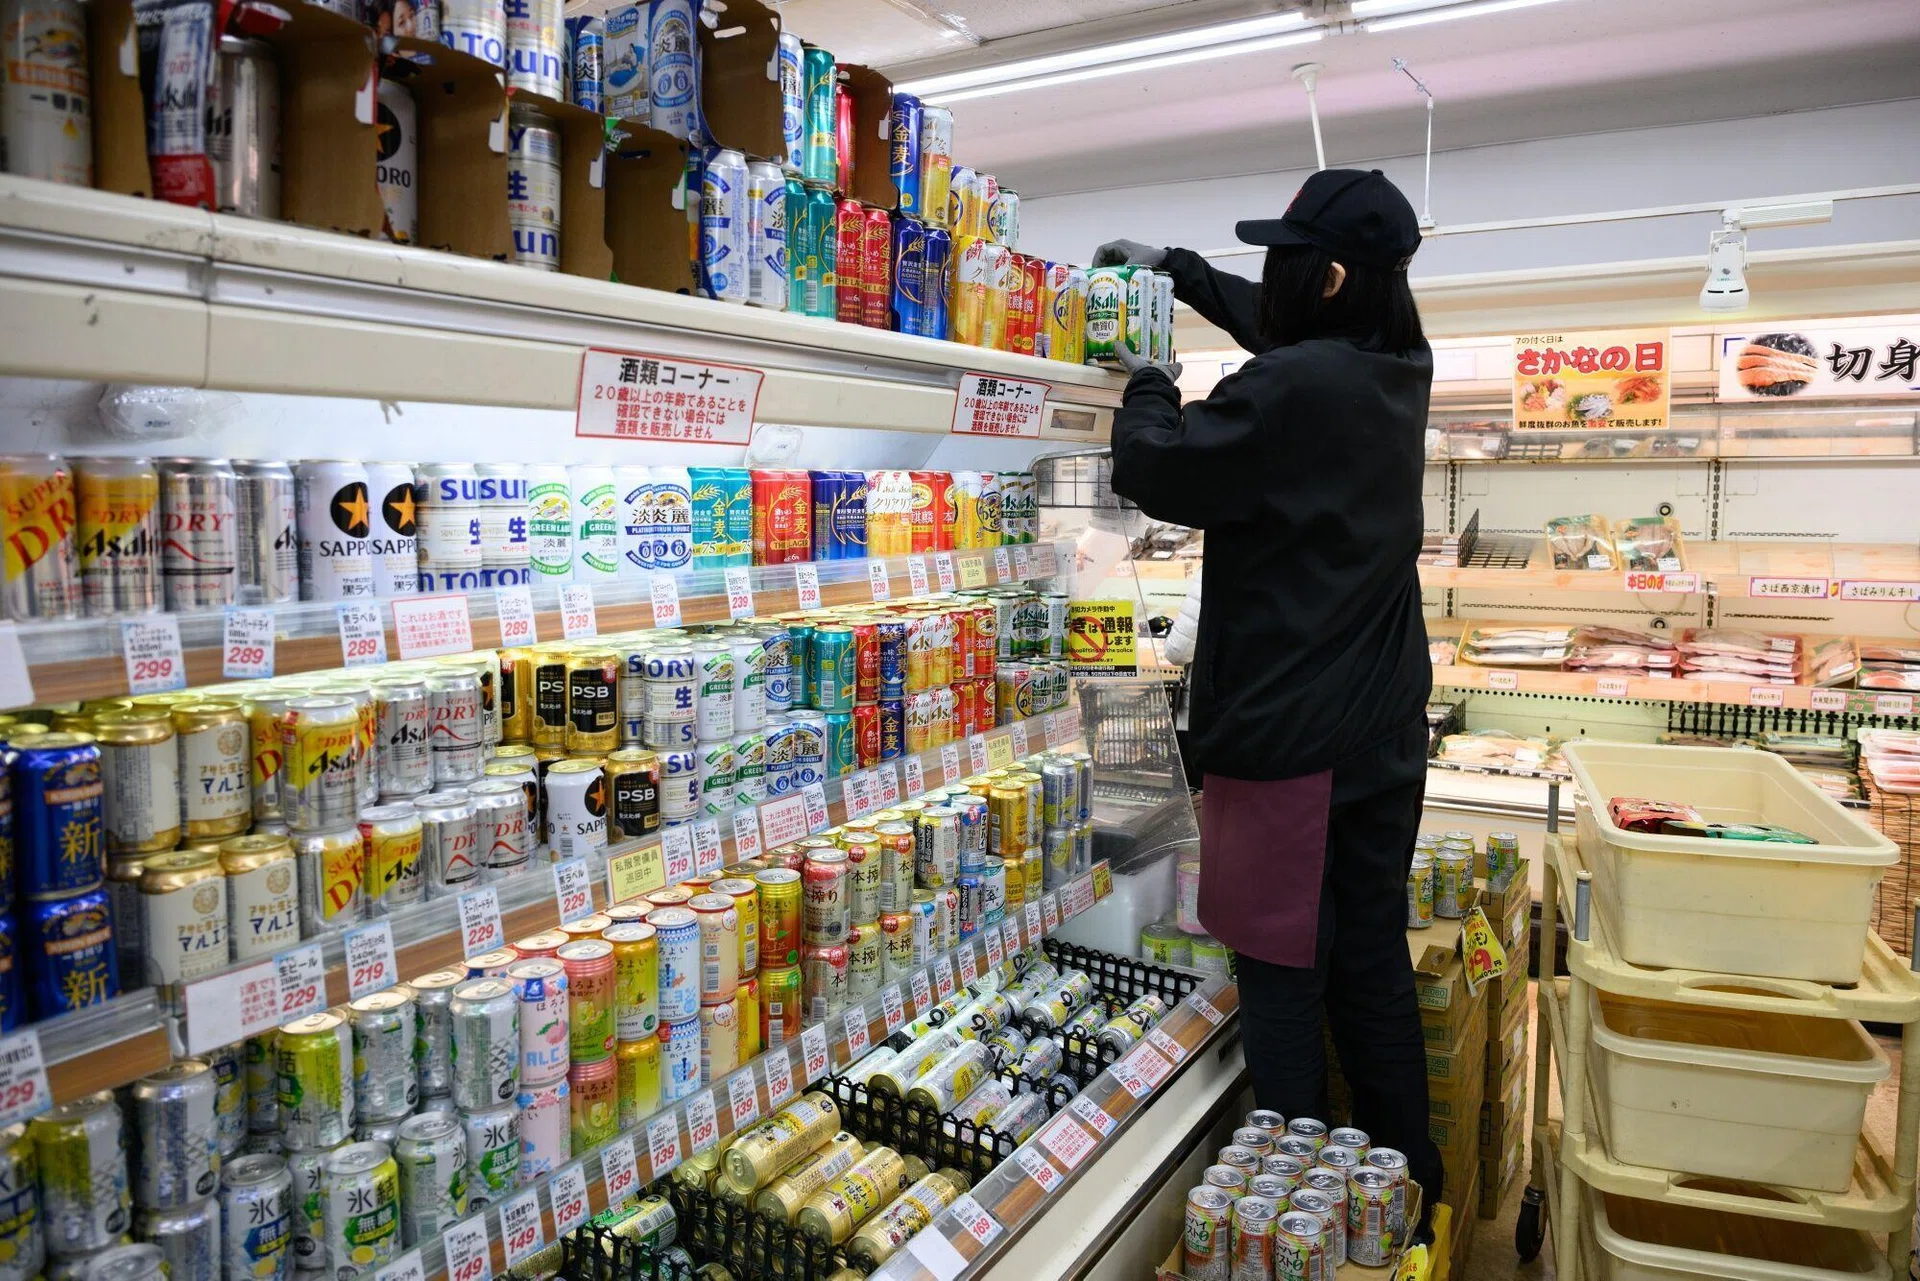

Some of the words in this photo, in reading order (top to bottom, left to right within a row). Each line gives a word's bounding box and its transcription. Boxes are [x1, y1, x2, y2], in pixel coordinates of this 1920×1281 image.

[892, 125, 911, 166] 金麦
[1515, 335, 1564, 345] 7の付く日は
[1516, 341, 1664, 376] さかなの日
[1825, 336, 1920, 384] 切身
[618, 357, 731, 389] 酒類コーナー
[976, 378, 1032, 399] 酒類コーナー
[594, 384, 747, 413] 20歳以上の年齢であることを
[964, 397, 1040, 415] 20歳以上の年齢であることを
[616, 403, 726, 426] 確認できない場合には
[972, 409, 1028, 425] 確認できない場合には
[615, 419, 714, 439] 酒類を販売しません
[971, 420, 1021, 435] 酒類を販売しません
[711, 498, 726, 538] 金麦
[792, 497, 809, 535] 金麦
[508, 516, 527, 543] 生
[873, 582, 886, 594] 239
[913, 578, 926, 590] 239
[941, 575, 952, 585] 239
[801, 589, 816, 602] 239
[1760, 583, 1821, 596] さば西京漬け
[1850, 586, 1915, 598] さばみりん干し
[732, 594, 749, 609] 239
[342, 612, 377, 625] 黒ラベル
[656, 603, 675, 619] 239
[504, 621, 528, 637] 289
[567, 614, 589, 630] 239
[347, 638, 377, 657] 289
[1106, 636, 1133, 646] します
[227, 646, 265, 665] 289
[133, 659, 173, 681] 299
[572, 685, 609, 698] PSB
[674, 685, 693, 710] 生
[883, 716, 899, 751] 金麦
[973, 756, 984, 769] 189
[945, 766, 957, 780] 189
[882, 788, 897, 801] 189
[908, 778, 921, 793] 189
[618, 788, 656, 802] PSB
[855, 797, 869, 811] 189
[808, 810, 825, 825] 189
[60, 816, 101, 865] 新
[738, 836, 757, 852] 189
[615, 852, 659, 872] 私服警備員
[699, 848, 717, 865] 219
[625, 867, 652, 885] 巡回中
[669, 858, 688, 876] 219
[563, 892, 585, 913] 229
[468, 924, 494, 946] 229
[1029, 924, 1039, 936] 199
[1006, 938, 1018, 952] 199
[990, 948, 1000, 963] 119
[278, 956, 319, 977] 生ビール
[353, 961, 385, 987] 219
[962, 966, 974, 981] 139
[63, 964, 108, 1010] 新
[939, 979, 951, 995] 149
[282, 984, 317, 1012] 229
[915, 992, 928, 1009] 149
[887, 1009, 901, 1026] 149
[850, 1031, 865, 1048] 149
[808, 1055, 824, 1074] 139
[771, 1077, 788, 1097] 139
[1127, 1078, 1141, 1092] 179
[735, 1098, 753, 1119] 139
[692, 1122, 713, 1145] 139
[653, 1143, 675, 1168] 139
[609, 1169, 631, 1195] 139
[1037, 1167, 1053, 1185] 169
[557, 1200, 582, 1225] 139
[973, 1216, 991, 1238] 169
[508, 1226, 535, 1254] 149
[455, 1256, 482, 1281] 149
